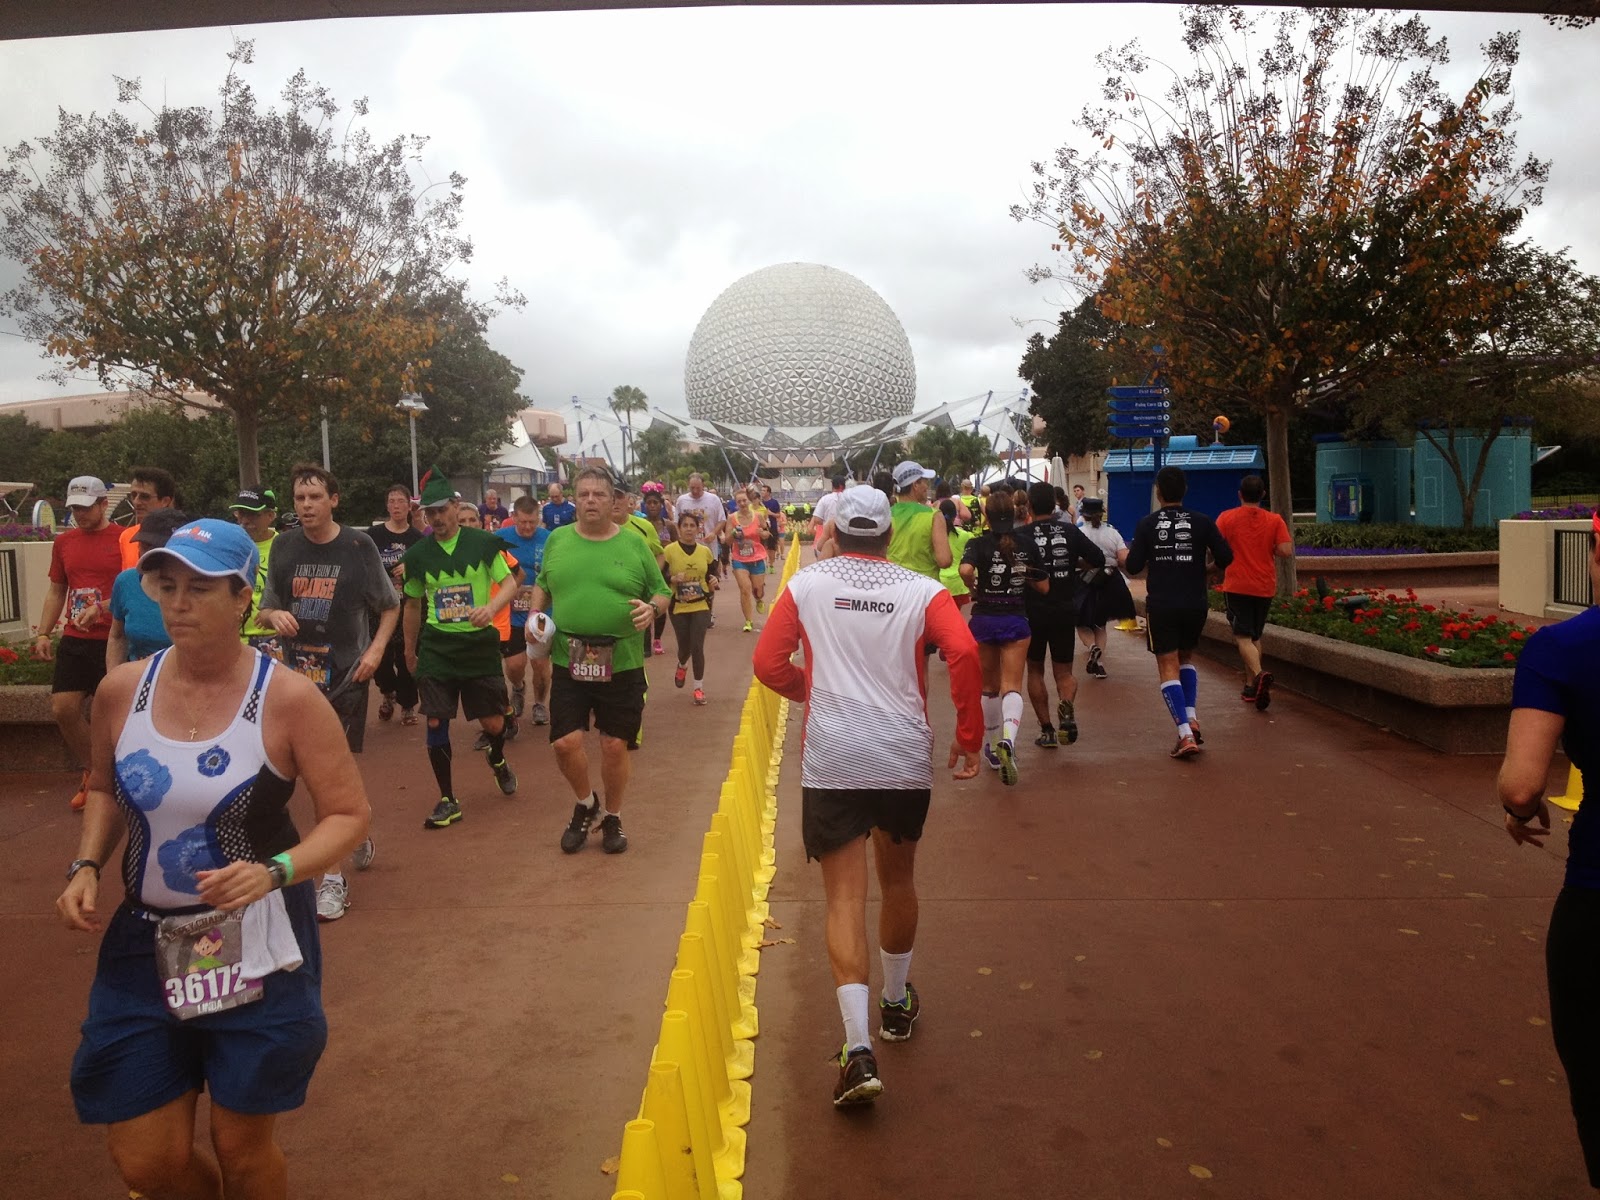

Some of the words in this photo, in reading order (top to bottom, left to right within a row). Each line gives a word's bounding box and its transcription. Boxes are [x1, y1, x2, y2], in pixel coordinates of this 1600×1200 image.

[292, 576, 338, 600] ORANGE
[298, 598, 333, 621] BLUE
[851, 599, 895, 614] MARCO
[572, 662, 606, 677] 35181
[164, 962, 247, 1009] 36172
[197, 999, 224, 1015] LINDA
